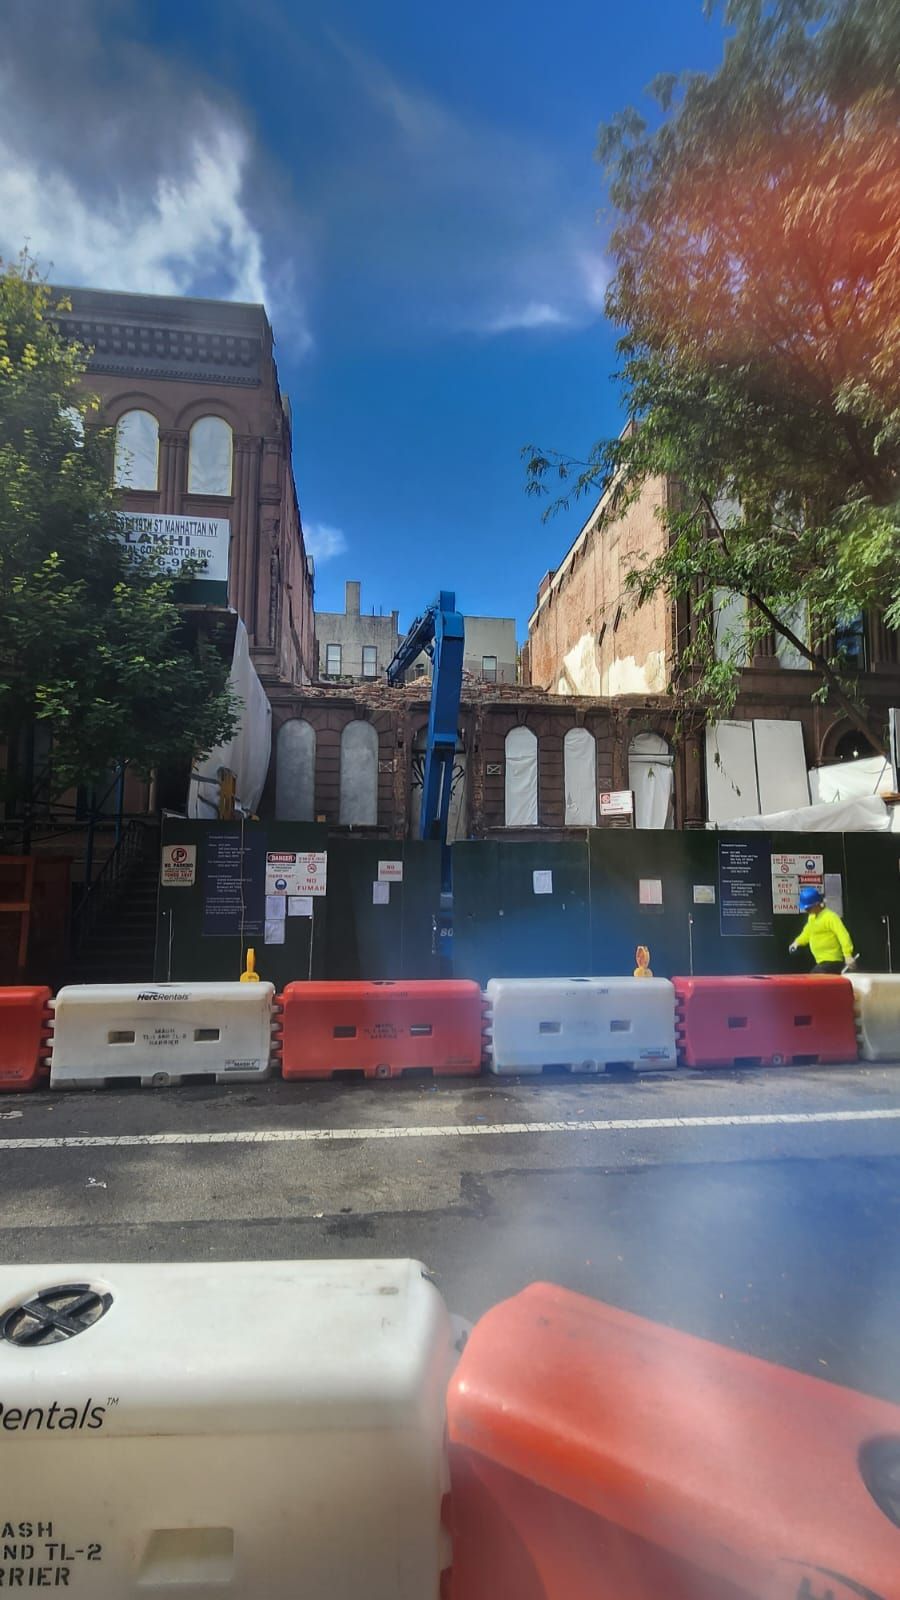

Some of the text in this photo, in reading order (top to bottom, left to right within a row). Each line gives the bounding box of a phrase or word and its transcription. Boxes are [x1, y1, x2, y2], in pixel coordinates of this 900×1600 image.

[154, 518, 163, 533] ST
[165, 520, 206, 536] MANHATTAN
[208, 523, 219, 537] NY
[125, 532, 191, 546] LAKHI
[271, 854, 293, 862] DANGER
[45, 1543, 102, 1561] TL-2
